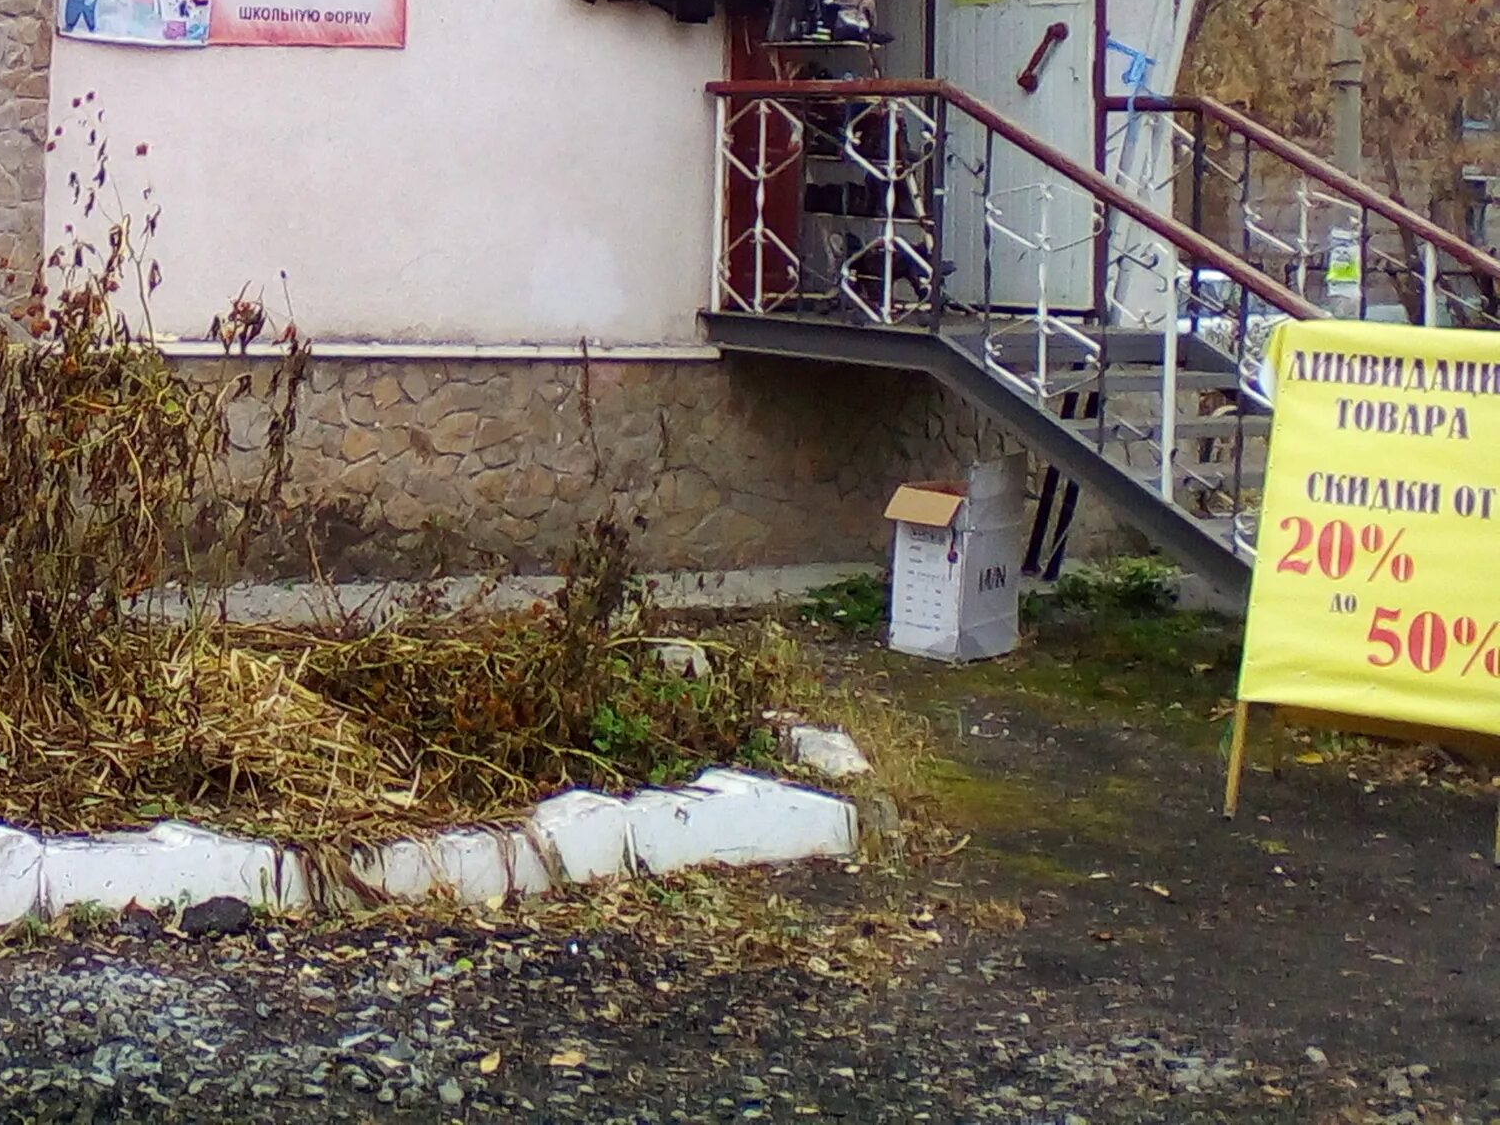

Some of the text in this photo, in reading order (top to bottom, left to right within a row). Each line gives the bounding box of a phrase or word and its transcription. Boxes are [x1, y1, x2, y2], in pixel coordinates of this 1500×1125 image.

[239, 6, 371, 25] ШКОЛЬНУЮ ФОРМУ
[1335, 398, 1469, 440] ТОВАРА
[1306, 472, 1497, 520] СКИДКИ ОТ
[1276, 516, 1415, 583] 20%
[1367, 606, 1500, 678] 50%
